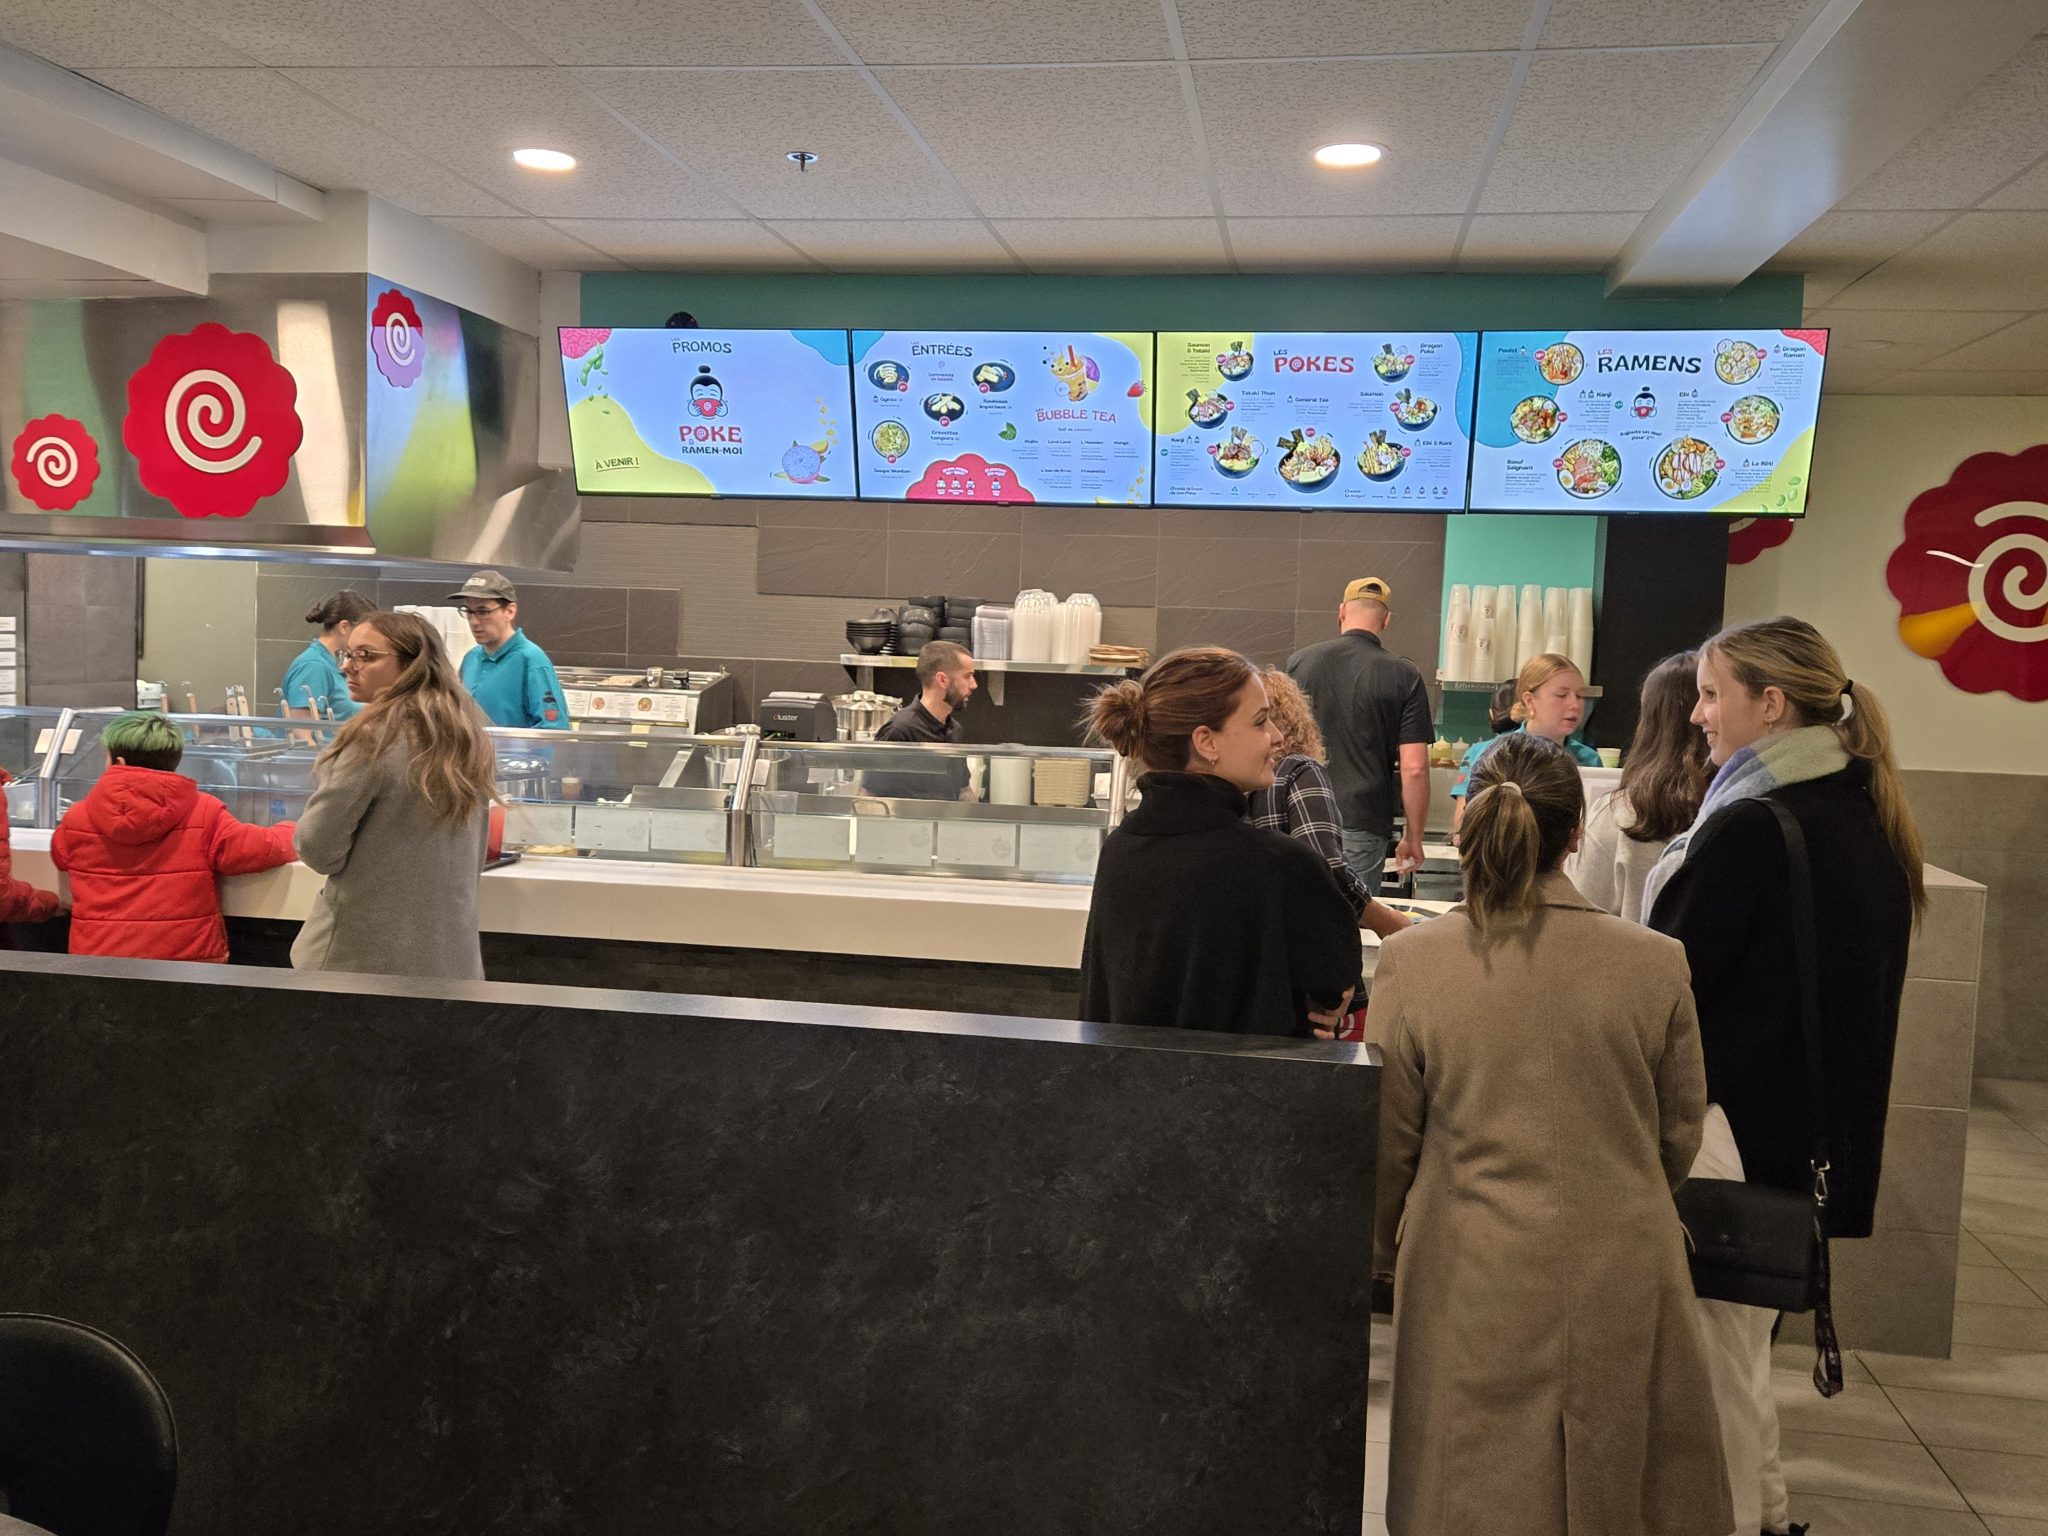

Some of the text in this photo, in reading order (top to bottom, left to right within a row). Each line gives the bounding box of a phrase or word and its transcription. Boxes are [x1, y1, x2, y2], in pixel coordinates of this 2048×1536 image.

[672, 341, 732, 353] PROMOS
[912, 343, 972, 357] ENTRÉES
[1275, 356, 1354, 373] POKES
[1598, 355, 1702, 374] RAMENS
[1037, 409, 1116, 423] BUBBLE TEA
[679, 425, 743, 443] POKE
[682, 446, 743, 455] RAMEN-MOI
[595, 459, 602, 469] À
[604, 457, 633, 467] VENIR
